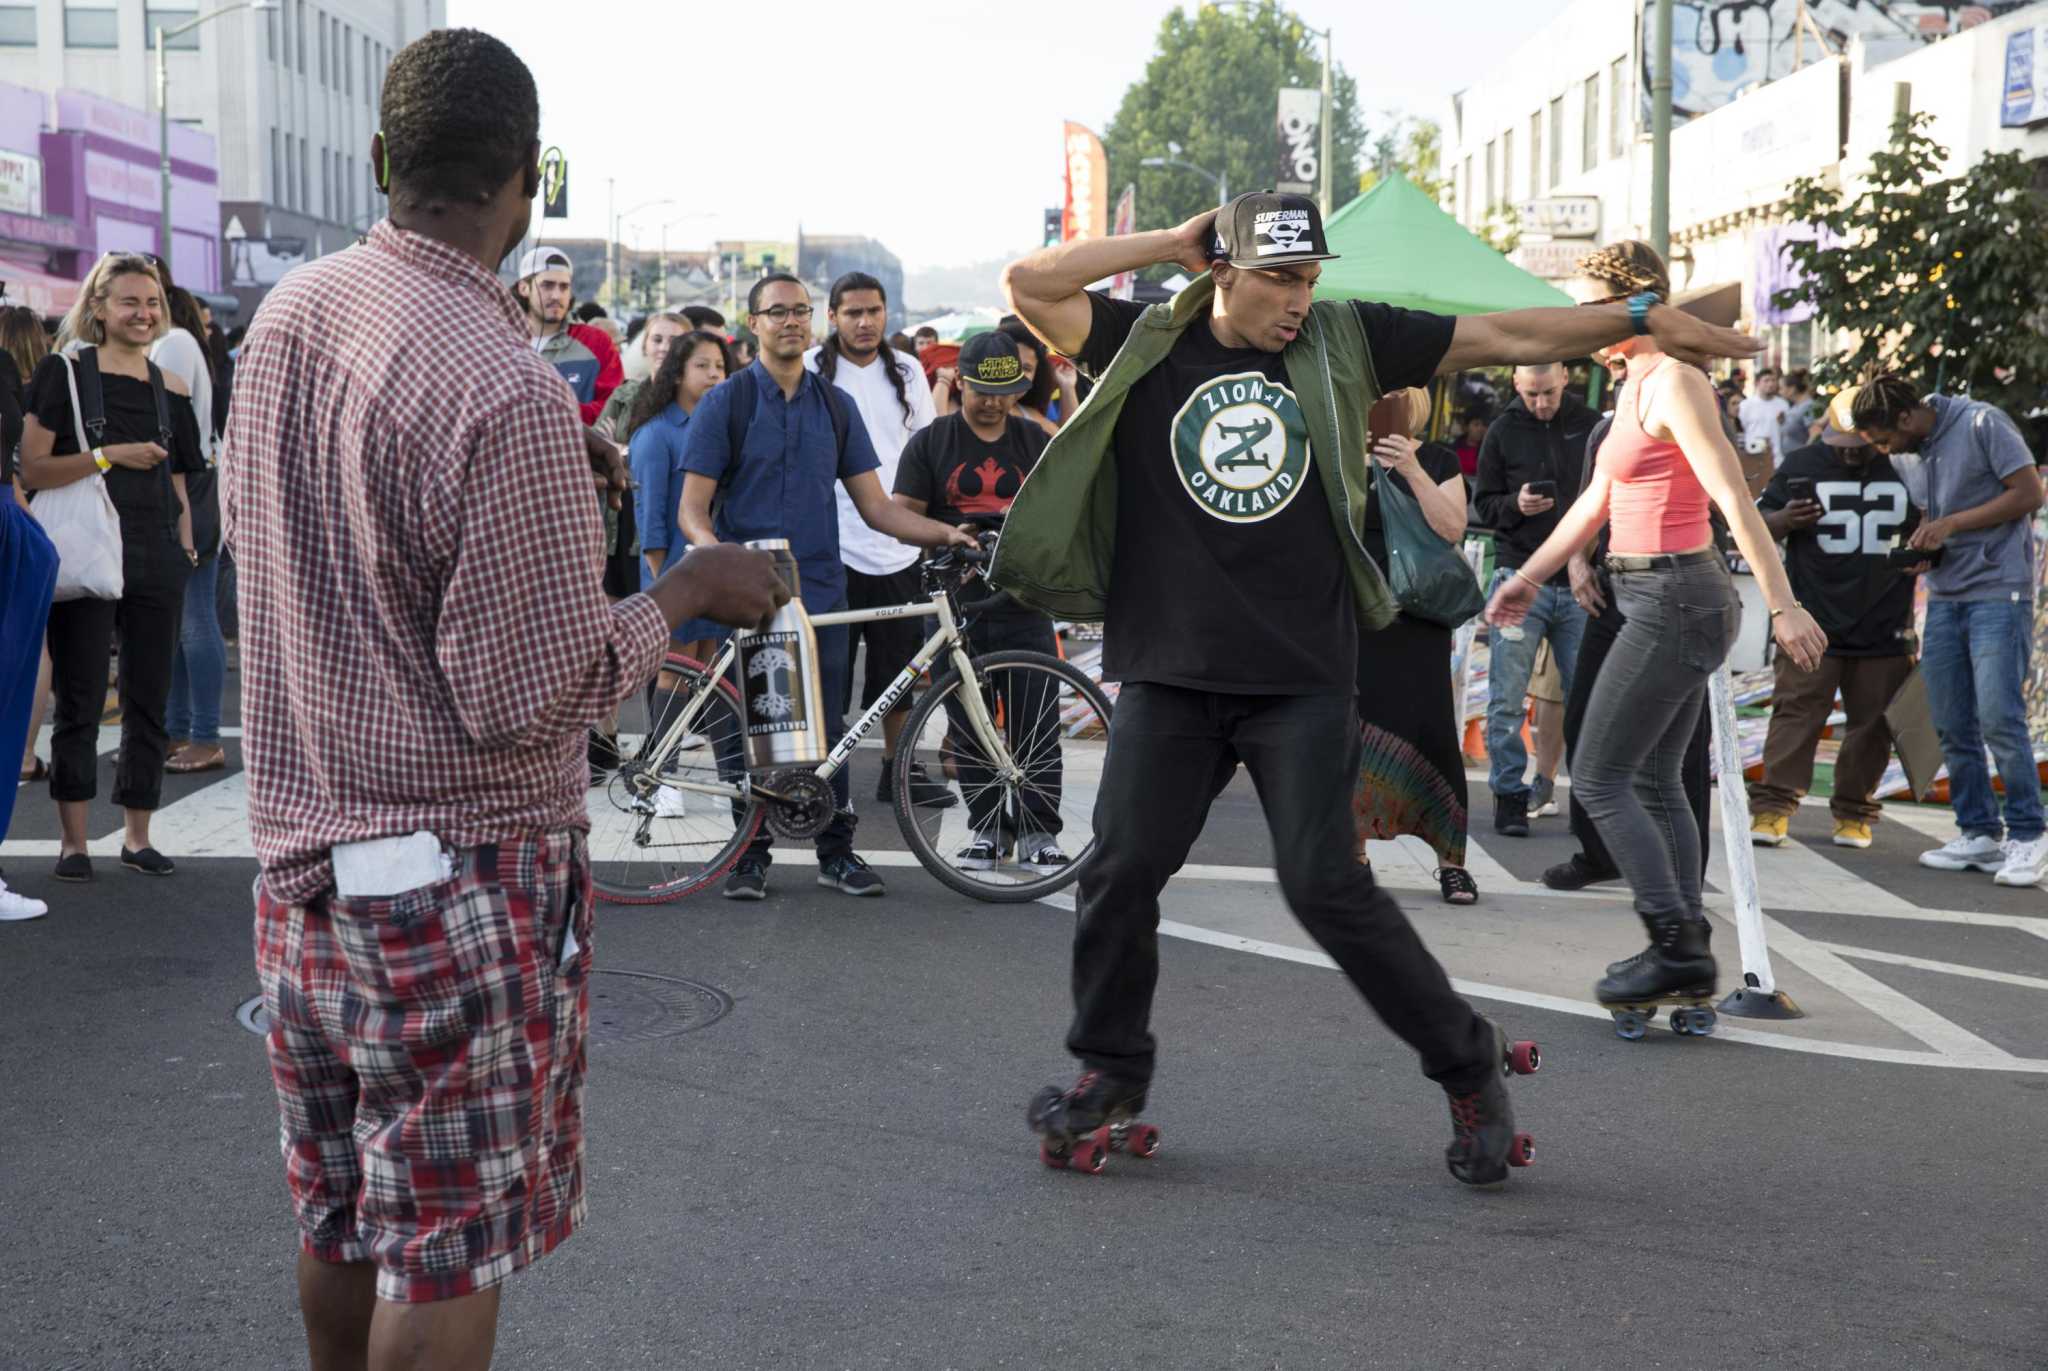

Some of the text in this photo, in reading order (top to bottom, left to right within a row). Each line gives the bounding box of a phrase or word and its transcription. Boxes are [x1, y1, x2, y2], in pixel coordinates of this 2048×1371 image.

[1254, 210, 1309, 223] SUPERMAN
[978, 356, 1019, 369] STAR
[979, 367, 1017, 379] WARS
[1191, 472, 1293, 512] OAKLAND
[1816, 481, 1908, 555] 52
[741, 632, 799, 647] OAKLANDISH
[837, 677, 909, 758] Bianchi
